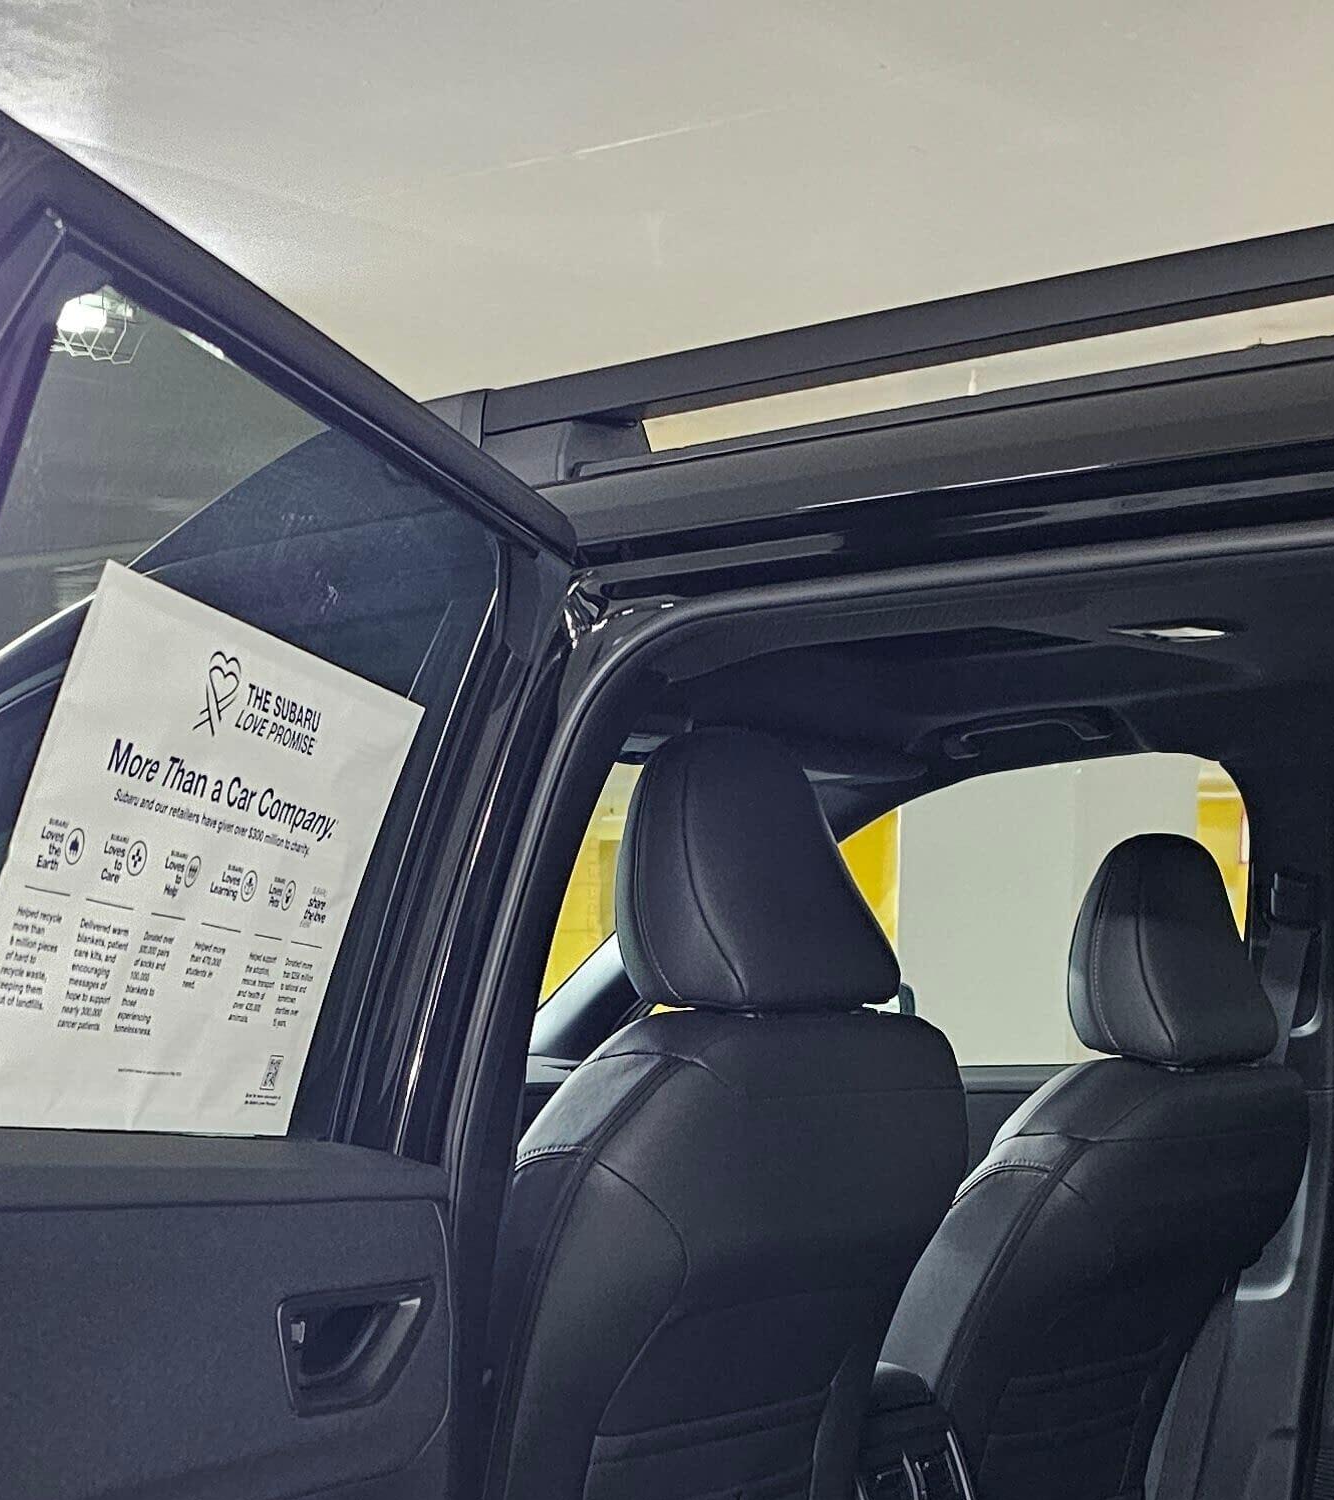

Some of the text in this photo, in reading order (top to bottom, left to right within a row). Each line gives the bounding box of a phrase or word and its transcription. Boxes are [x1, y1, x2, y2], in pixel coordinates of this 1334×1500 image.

[247, 683, 321, 733] THE SUBARU
[235, 710, 269, 737] LOVE
[107, 738, 336, 842] More Than a Car Company.
[114, 788, 139, 806] Subaru
[139, 798, 155, 810] and
[155, 802, 169, 814] our
[168, 807, 200, 824] retailers
[201, 813, 217, 829] have
[217, 821, 234, 834] given
[234, 826, 248, 836] over
[248, 827, 264, 842] $300
[264, 834, 284, 847] million
[284, 839, 290, 850] to
[41, 826, 65, 843] Loves
[48, 843, 61, 857] the
[104, 841, 126, 858] Loves
[36, 854, 59, 870] Earth
[114, 859, 122, 871] to
[165, 856, 185, 873] Loves
[101, 868, 120, 883] Care
[175, 874, 182, 885] to
[222, 871, 241, 886] Loves
[164, 884, 178, 898] Help
[210, 882, 238, 901] Learning
[268, 884, 283, 897] Loves
[307, 897, 326, 910] share
[303, 909, 326, 924] the love
